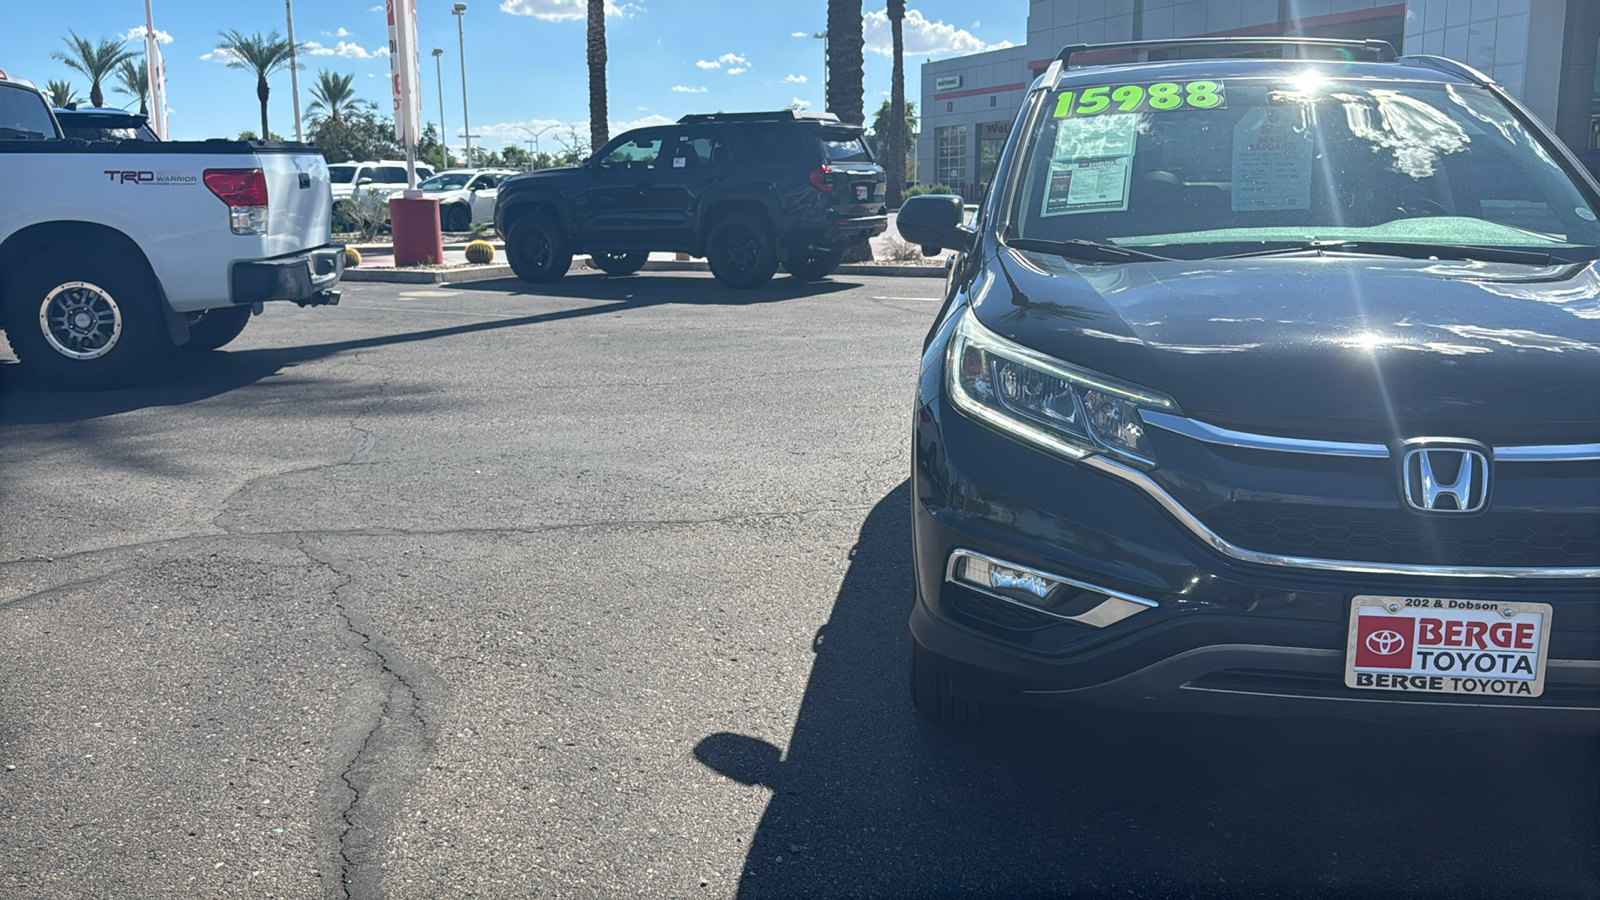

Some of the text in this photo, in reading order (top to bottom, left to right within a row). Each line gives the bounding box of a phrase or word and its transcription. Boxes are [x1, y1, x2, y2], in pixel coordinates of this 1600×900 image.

[1053, 81, 1224, 118] 15988
[1249, 142, 1297, 152] BARGAINS
[104, 170, 154, 185] TRD
[1405, 598, 1498, 611] 202 & Dobson
[1418, 617, 1535, 650] BERGE
[1417, 651, 1533, 674] TOYOTA
[1356, 673, 1532, 695] BERGE TOYOTA
